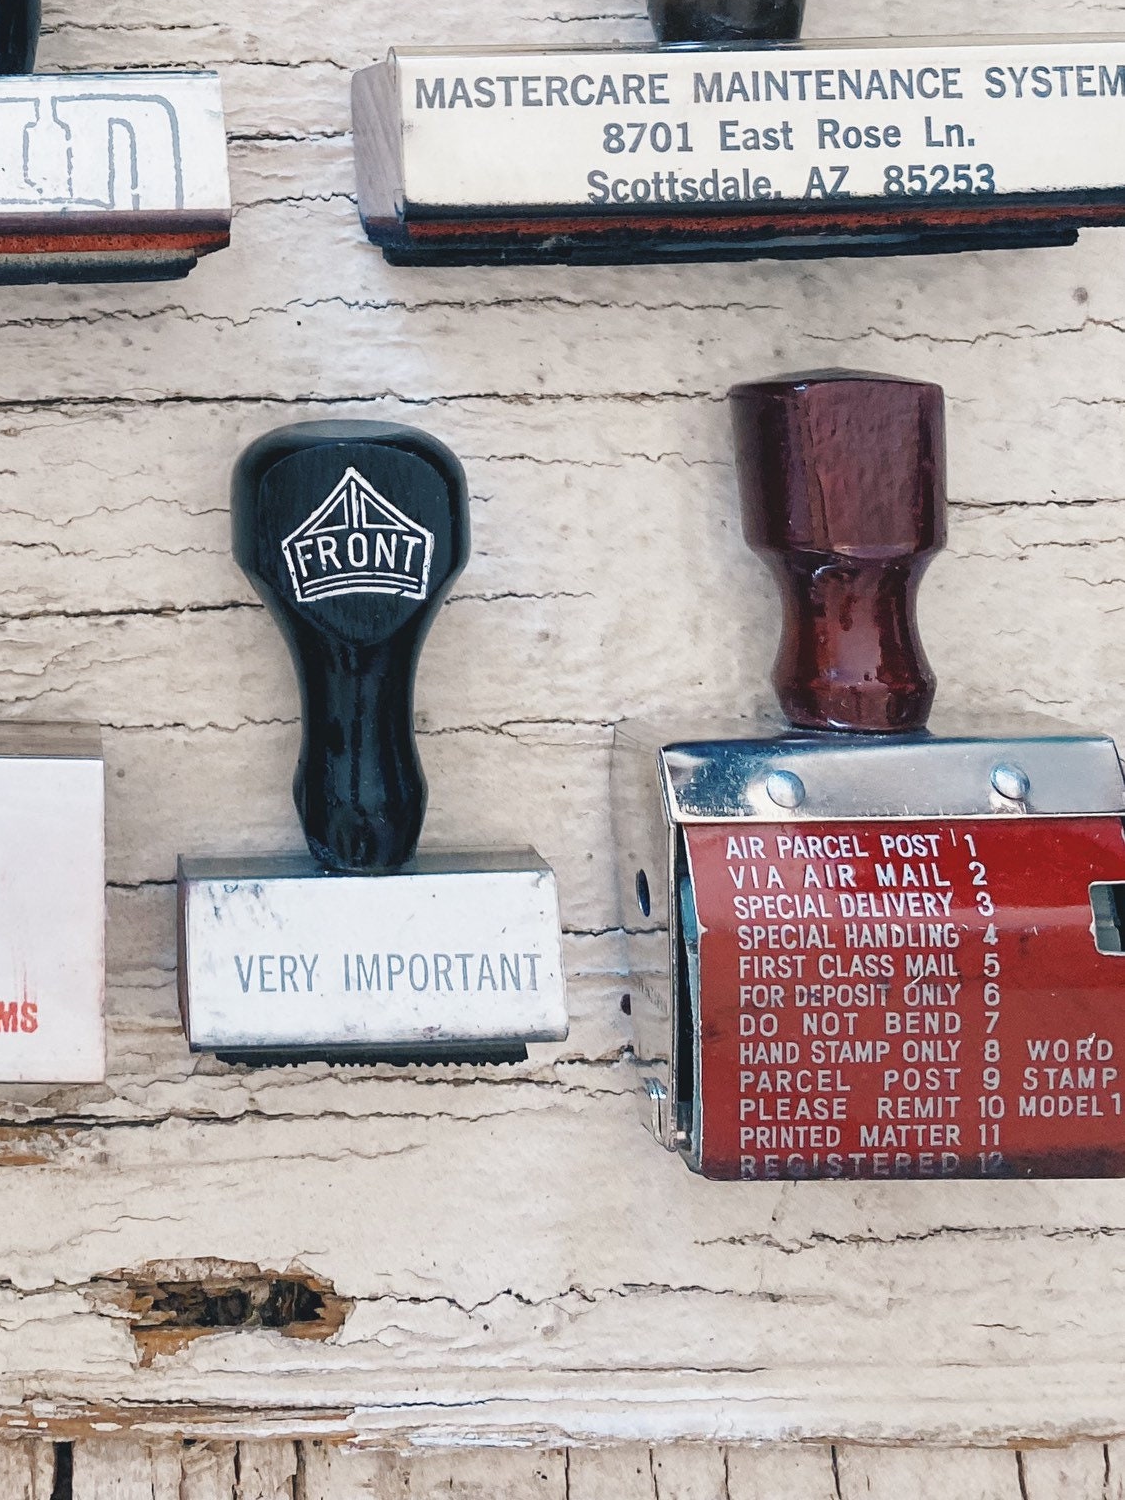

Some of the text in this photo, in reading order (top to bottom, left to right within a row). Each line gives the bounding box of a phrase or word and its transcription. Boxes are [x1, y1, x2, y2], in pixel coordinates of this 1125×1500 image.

[415, 64, 1125, 109] MASTERCARE MAINTENANCE SYSTEM
[602, 116, 976, 154] 8701 East Rose Ln.
[806, 166, 850, 199] AZ
[884, 163, 995, 196] 85253
[295, 532, 423, 577] FRONT
[726, 833, 977, 860] AIR PARCEL POST 1
[727, 862, 987, 889] VIA AIR MAIL 2
[733, 892, 994, 920] SPECIAL DELIVERY 3
[737, 923, 999, 950] SPECIAL HANDLING 4
[234, 953, 542, 993] VERY IMPORTANT
[738, 953, 1000, 979] FIRST CLASS MAIL 5
[738, 983, 1000, 1008] FOR DEPOSIT ONLY 6
[739, 1011, 1000, 1037] DO NOT BEND 7
[739, 1040, 1001, 1065] HAND STAMP ONLY 8
[1027, 1039, 1114, 1062] WORD
[739, 1067, 1000, 1093] PARCEL POST 9
[1023, 1067, 1118, 1091] STAMP
[739, 1096, 1005, 1121] PLEASE REMIT 10
[1018, 1095, 1104, 1118] MODEL
[739, 1124, 1000, 1150] PRINTED MATTER 11
[739, 1152, 960, 1178] REGISTERED
